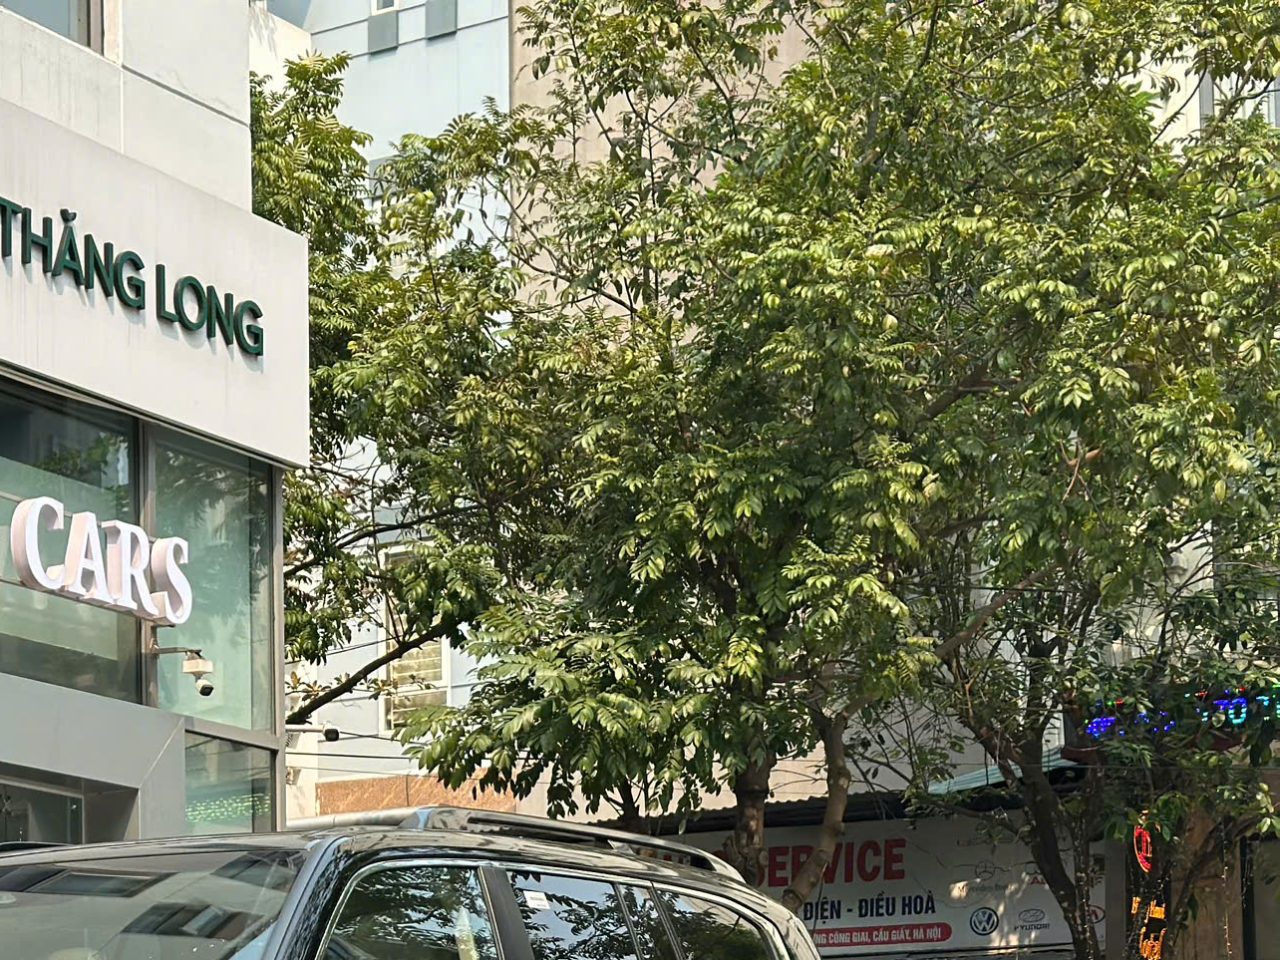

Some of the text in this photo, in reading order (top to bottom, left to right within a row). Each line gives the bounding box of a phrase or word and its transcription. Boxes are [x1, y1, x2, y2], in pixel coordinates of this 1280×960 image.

[156, 264, 263, 356] LONG
[12, 496, 194, 626] CARS
[756, 838, 906, 888] ERVICE
